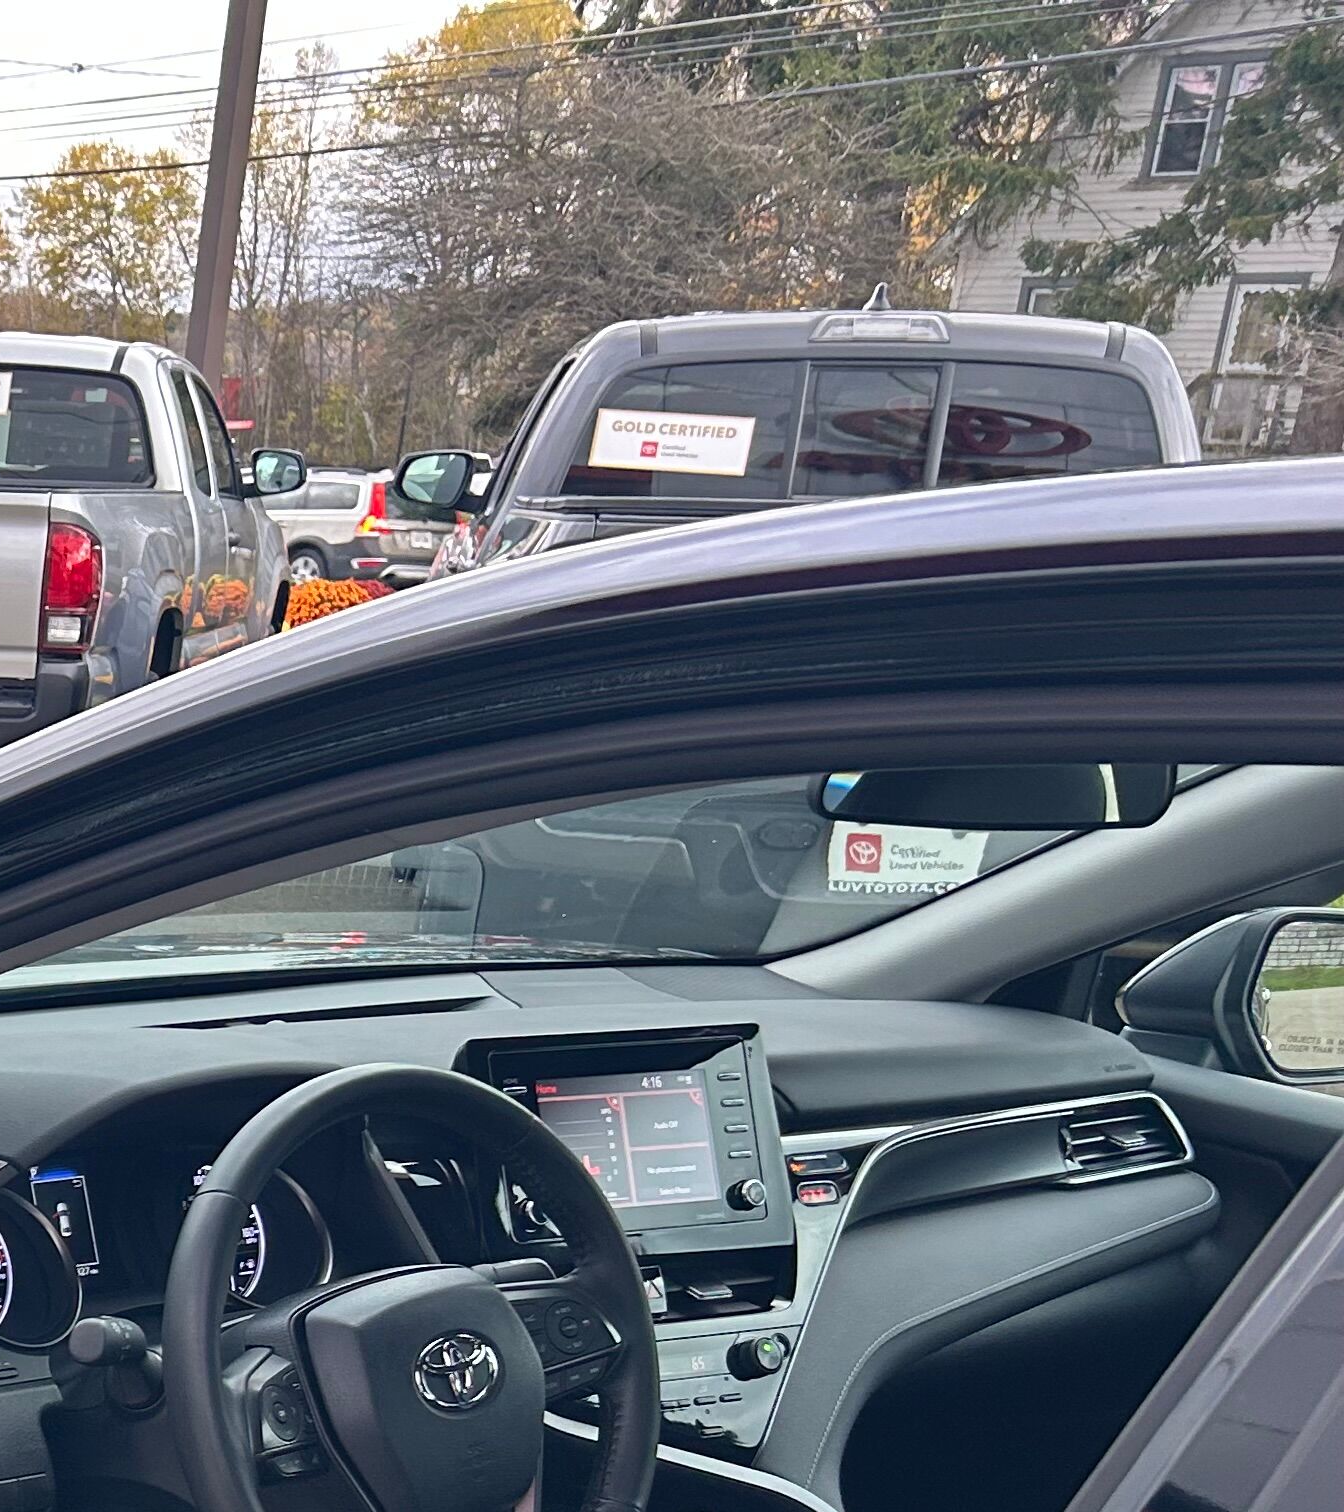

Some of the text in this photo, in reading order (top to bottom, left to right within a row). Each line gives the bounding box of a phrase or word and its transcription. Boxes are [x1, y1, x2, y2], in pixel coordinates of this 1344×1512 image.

[612, 420, 737, 439] GOLD CERTIFIED
[890, 844, 941, 858] Certified
[889, 861, 964, 870] Used Vehicles
[535, 1084, 558, 1094] Home
[691, 1355, 705, 1370] 65
